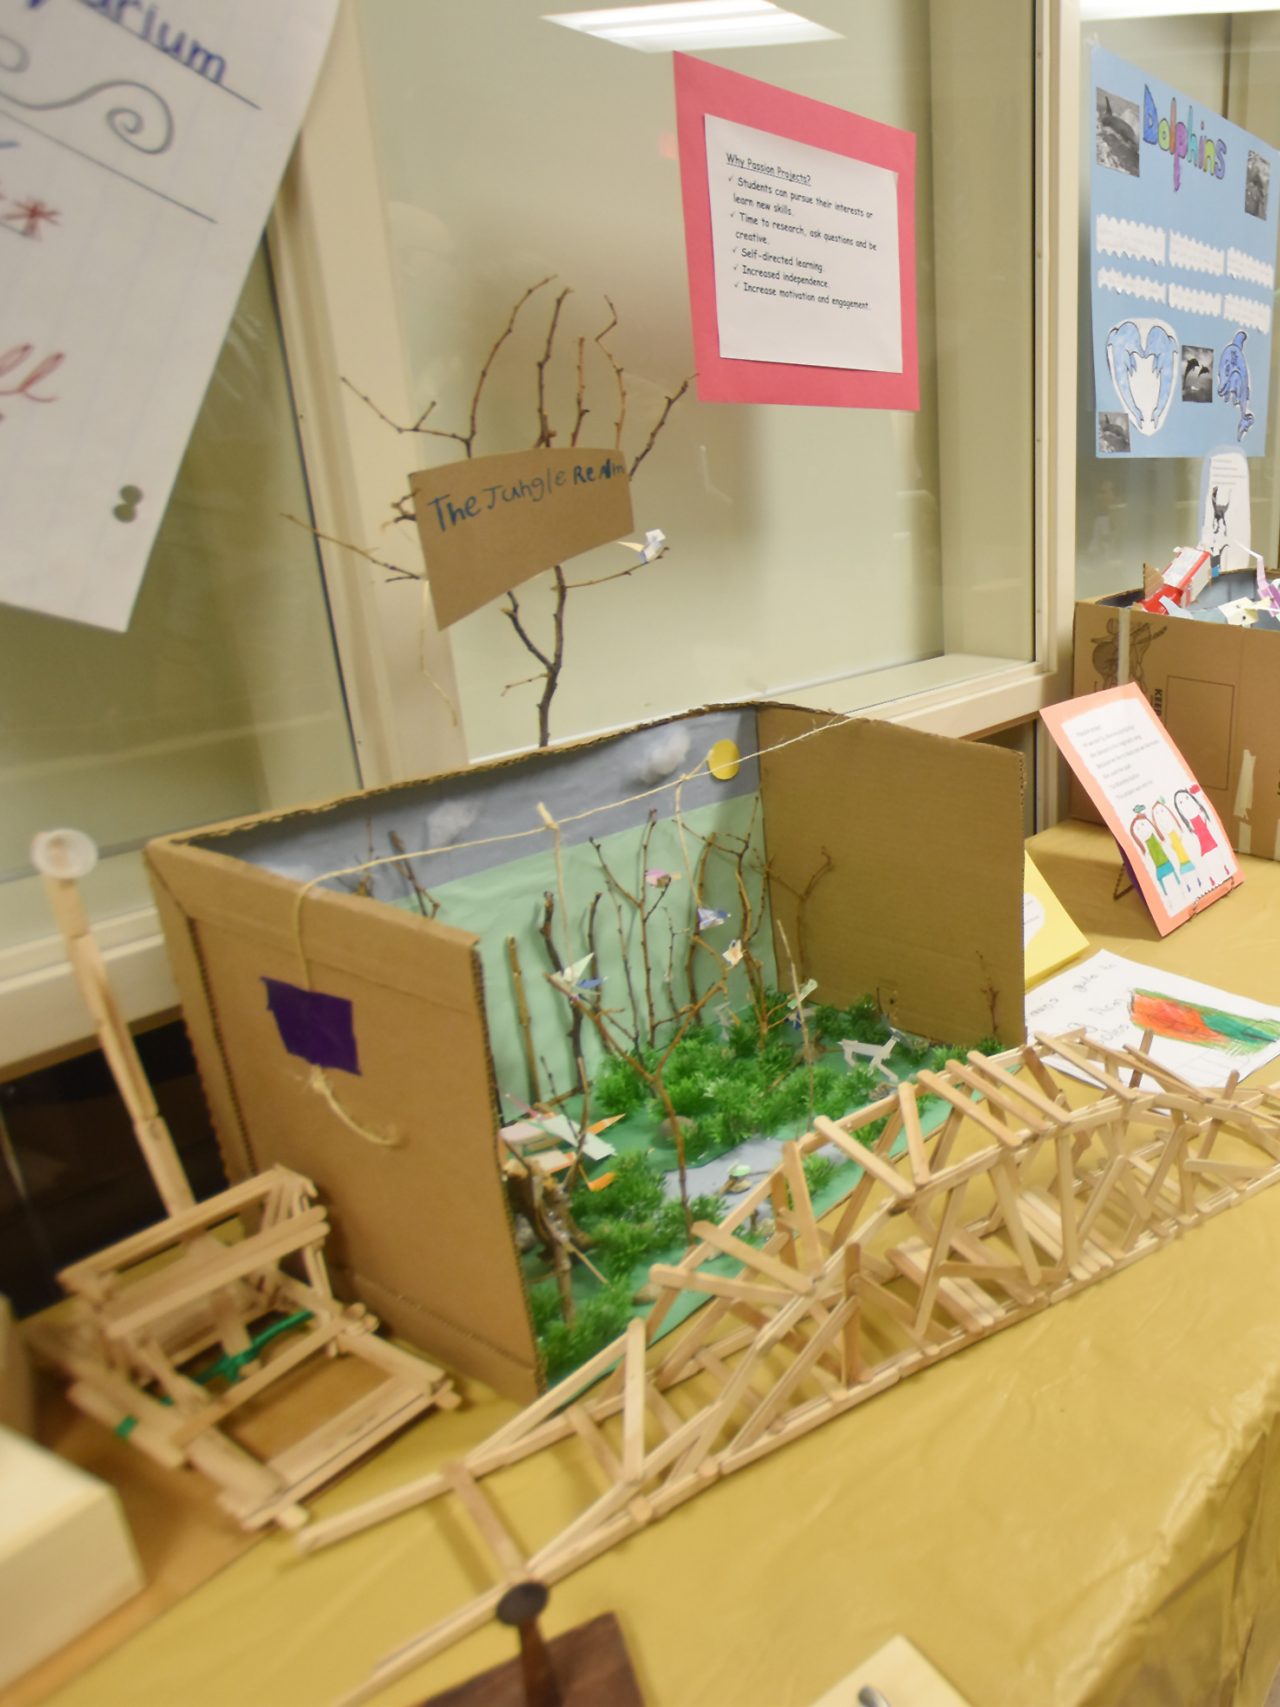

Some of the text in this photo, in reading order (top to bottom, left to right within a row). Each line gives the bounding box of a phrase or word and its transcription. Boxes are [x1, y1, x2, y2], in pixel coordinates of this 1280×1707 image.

[1142, 83, 1228, 192] Dolphins
[726, 152, 812, 183] Why Passion Projects?
[733, 193, 753, 207] learn
[756, 201, 771, 211] new
[737, 177, 773, 194] Students
[775, 188, 788, 198] can
[790, 191, 813, 205] pursue
[815, 197, 832, 209] their
[835, 201, 864, 217] interests
[739, 212, 758, 225] Time
[761, 218, 769, 228] to
[809, 228, 821, 238] ask
[824, 233, 853, 246] questions
[855, 239, 867, 249] and
[869, 240, 877, 250] be
[741, 248, 793, 266] Self-directed
[742, 265, 780, 281] Increased
[743, 282, 777, 297] Increase
[780, 289, 815, 302] motivation
[818, 295, 829, 305] and
[427, 494, 482, 532] The
[482, 468, 567, 510] Jungle
